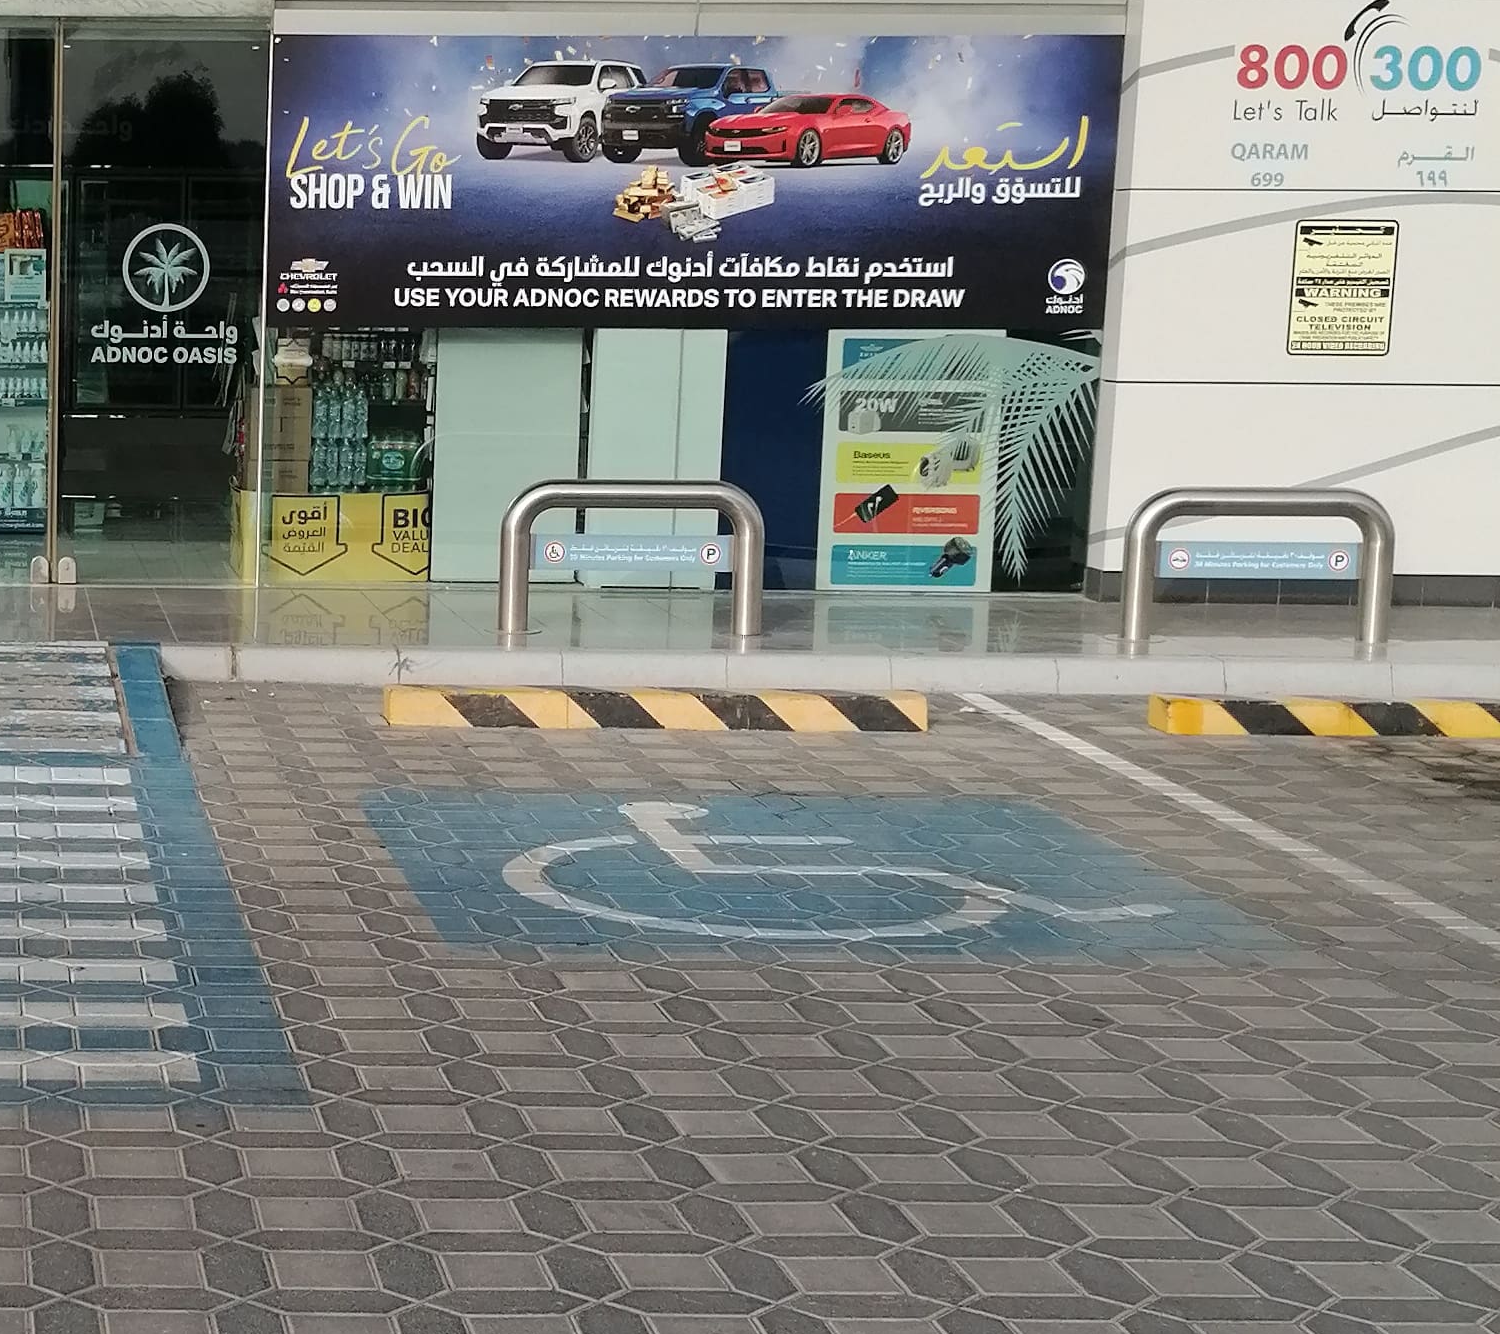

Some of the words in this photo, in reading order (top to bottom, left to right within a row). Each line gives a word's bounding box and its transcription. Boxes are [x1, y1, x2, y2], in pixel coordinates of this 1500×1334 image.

[1237, 44, 1348, 91] 800
[1370, 45, 1482, 92] 300
[1233, 100, 1283, 121] Let's
[1295, 99, 1338, 121] Talk
[1371, 99, 1479, 122] لنتواصل
[286, 116, 383, 179] Let's
[392, 116, 461, 180] Go
[1231, 143, 1309, 161] QARAM
[1397, 145, 1476, 167] القرم
[1250, 172, 1284, 187] 699
[290, 173, 365, 209] SHOP
[371, 174, 391, 209] &
[398, 174, 452, 209] WIN
[918, 176, 986, 207] والربح
[406, 255, 485, 281] السحب
[489, 256, 529, 287] في
[536, 254, 640, 283] للمشاركة
[646, 251, 714, 283] أدنوك
[804, 256, 860, 278] نقاط
[864, 255, 954, 284] استخدم
[393, 288, 440, 307] USE
[445, 288, 508, 307] YOUR
[513, 288, 600, 307] ADNOC
[604, 288, 719, 308] REWARDS
[723, 289, 756, 308] TO
[761, 289, 837, 308] ENTER
[842, 289, 888, 308] THE
[893, 289, 966, 308] DRAW
[1303, 288, 1381, 298] WARNING
[1045, 305, 1084, 314] ADNOC
[90, 314, 168, 344] أدنوك
[172, 320, 238, 345] واحة
[90, 346, 169, 364] ADNOC
[172, 347, 238, 364] OASIS
[855, 396, 899, 413] 20W
[853, 450, 891, 459] Baseus
[281, 501, 328, 525] أقوى
[282, 527, 326, 539] العروض
[393, 530, 429, 540] VALU
[391, 542, 429, 553] DEAL
[706, 548, 716, 559] P
[847, 549, 888, 560] ANKER
[1335, 555, 1344, 566] P
